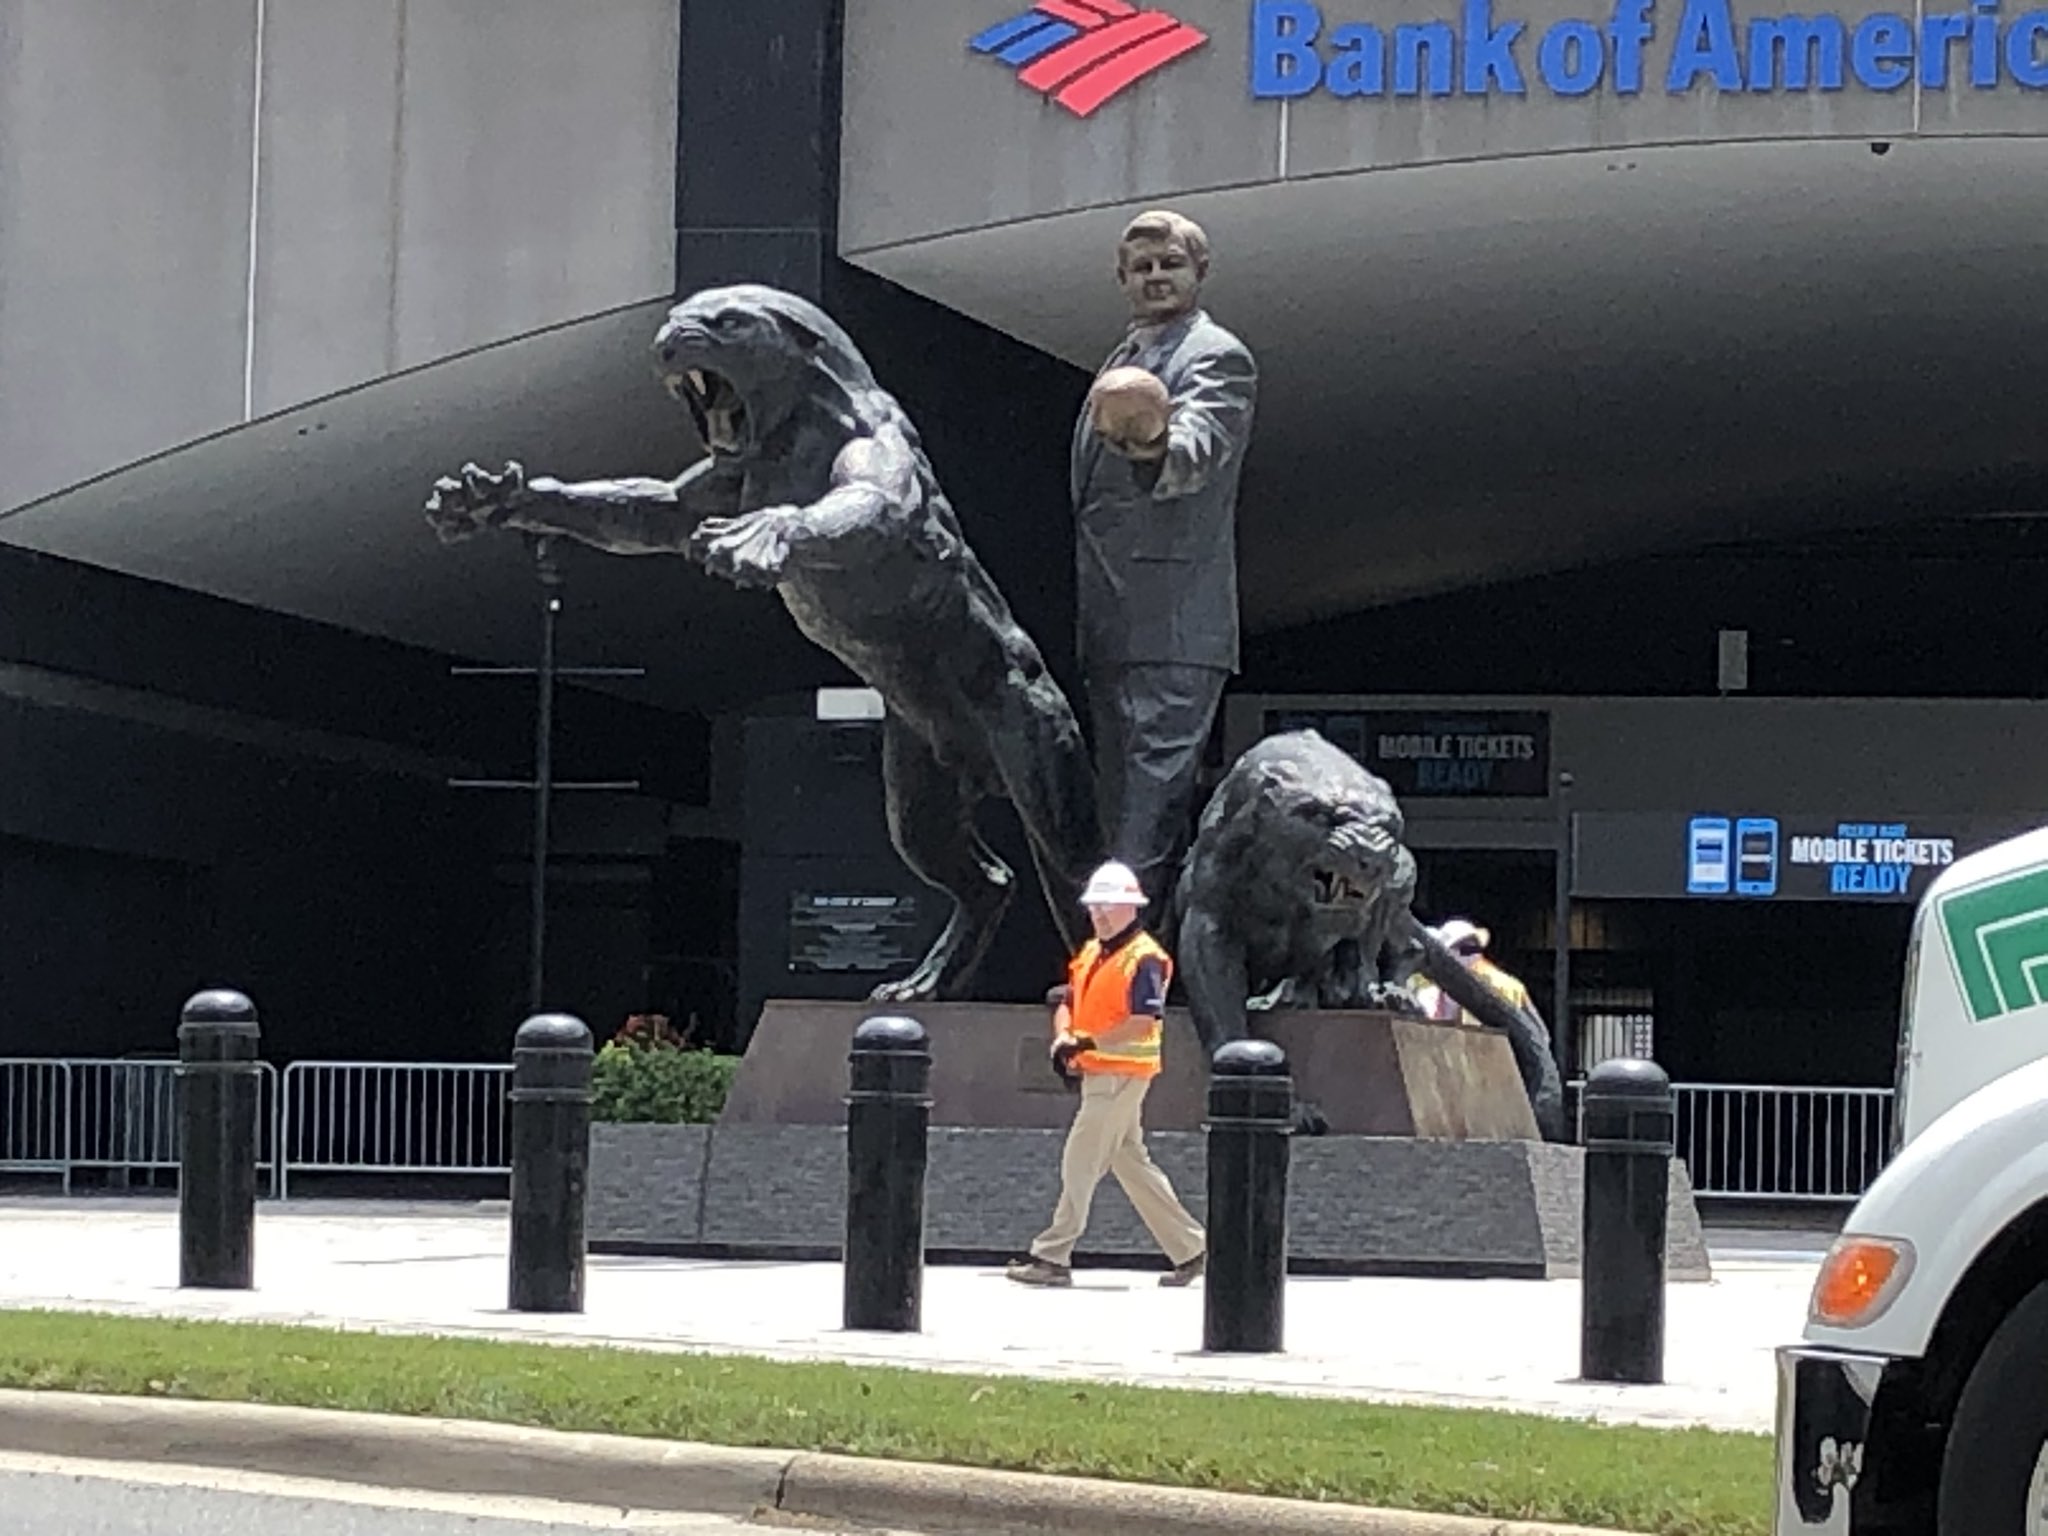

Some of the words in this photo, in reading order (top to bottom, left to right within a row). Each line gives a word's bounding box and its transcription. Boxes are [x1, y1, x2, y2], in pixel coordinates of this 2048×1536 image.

[1253, 0, 1525, 96] Bank
[1539, 0, 1654, 95] of
[1666, 0, 2048, 92] Americ
[1378, 734, 1451, 759] MOBILE
[1455, 734, 1535, 759] TICKETS
[1416, 760, 1494, 789] READY
[1790, 836, 1869, 864] MOBILE
[1872, 838, 1954, 865] TICKETS
[1831, 864, 1912, 894] READY
